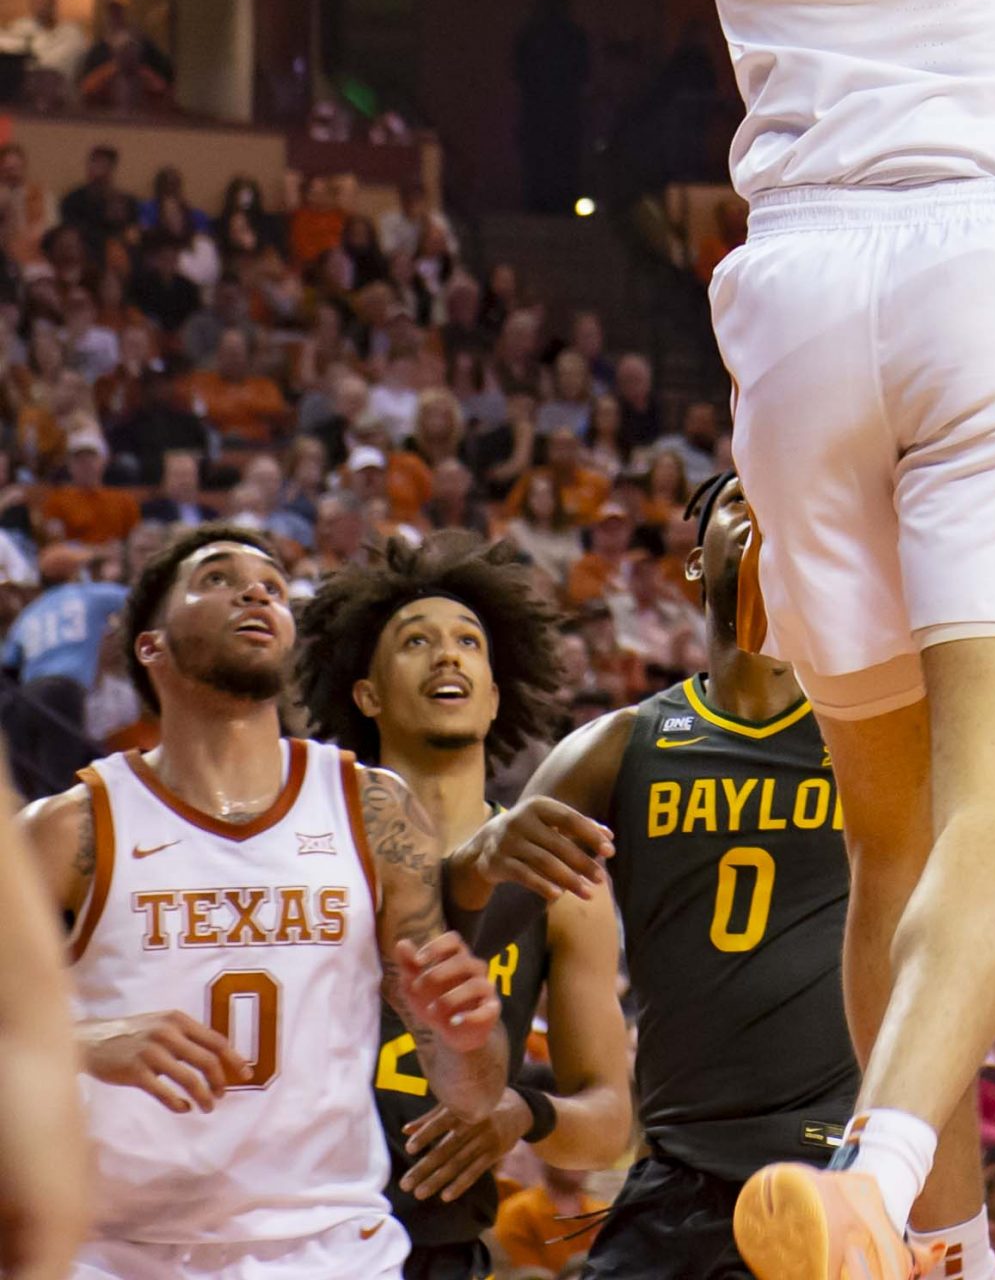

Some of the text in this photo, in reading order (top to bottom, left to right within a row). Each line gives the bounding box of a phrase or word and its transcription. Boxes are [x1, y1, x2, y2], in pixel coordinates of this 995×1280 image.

[132, 886, 349, 950] TEXAS
[710, 846, 776, 952] 0
[207, 967, 282, 1091] 0
